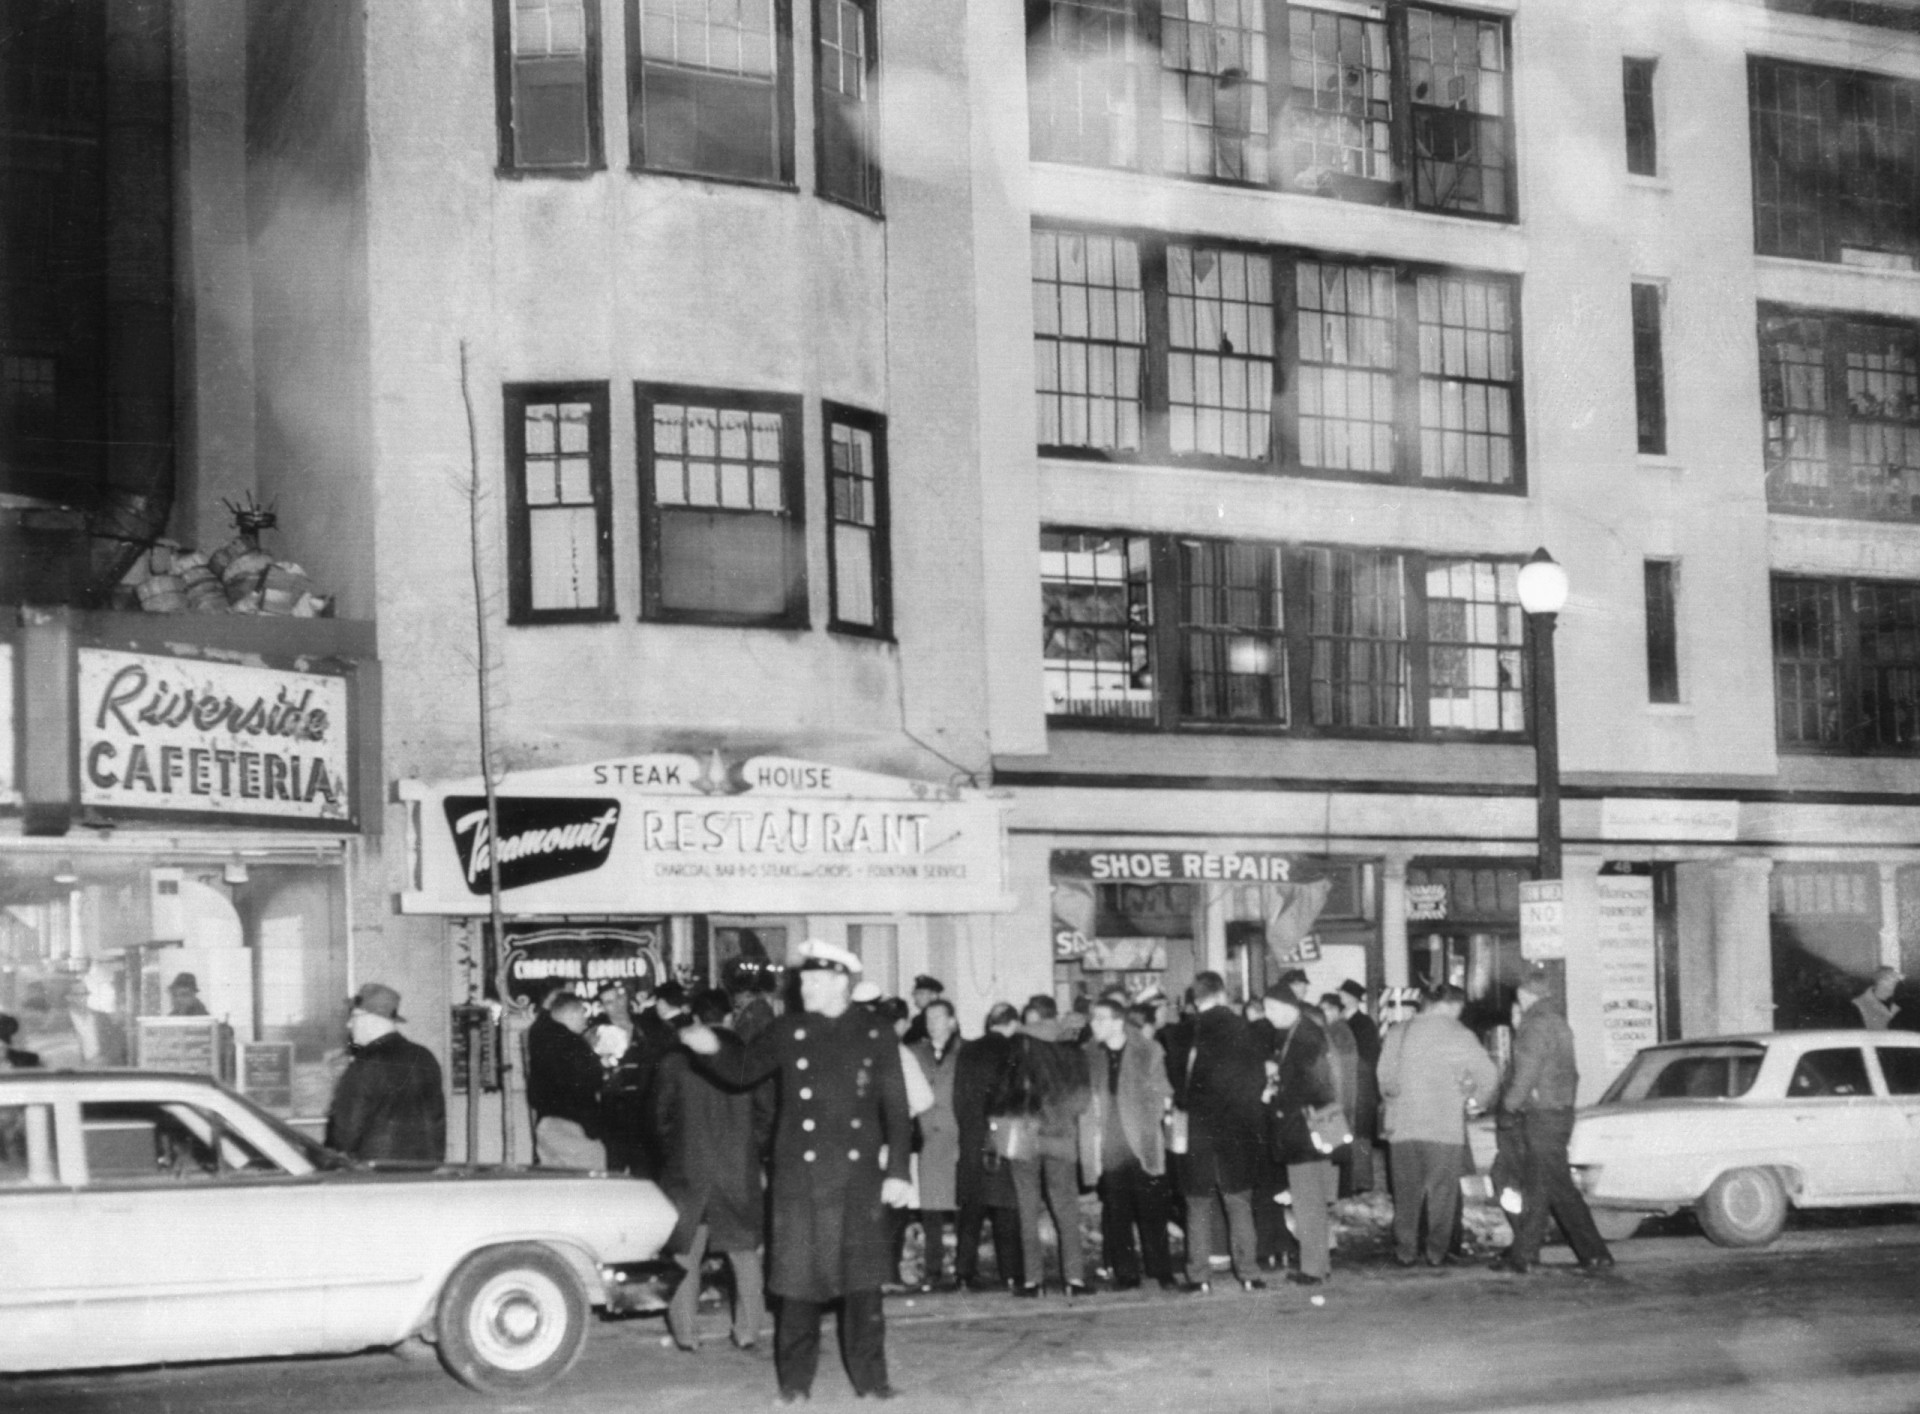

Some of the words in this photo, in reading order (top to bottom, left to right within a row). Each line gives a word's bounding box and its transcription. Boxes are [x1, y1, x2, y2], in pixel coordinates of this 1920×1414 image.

[96, 664, 330, 741] Riverside
[87, 741, 338, 803] CAFETERIA
[594, 764, 682, 785] STEAK
[758, 767, 832, 789] HOUSE
[456, 807, 617, 883] Paramount
[643, 809, 931, 854] RESTAURANT
[1090, 853, 1172, 879] SHOE
[1182, 853, 1291, 881] REPAIR
